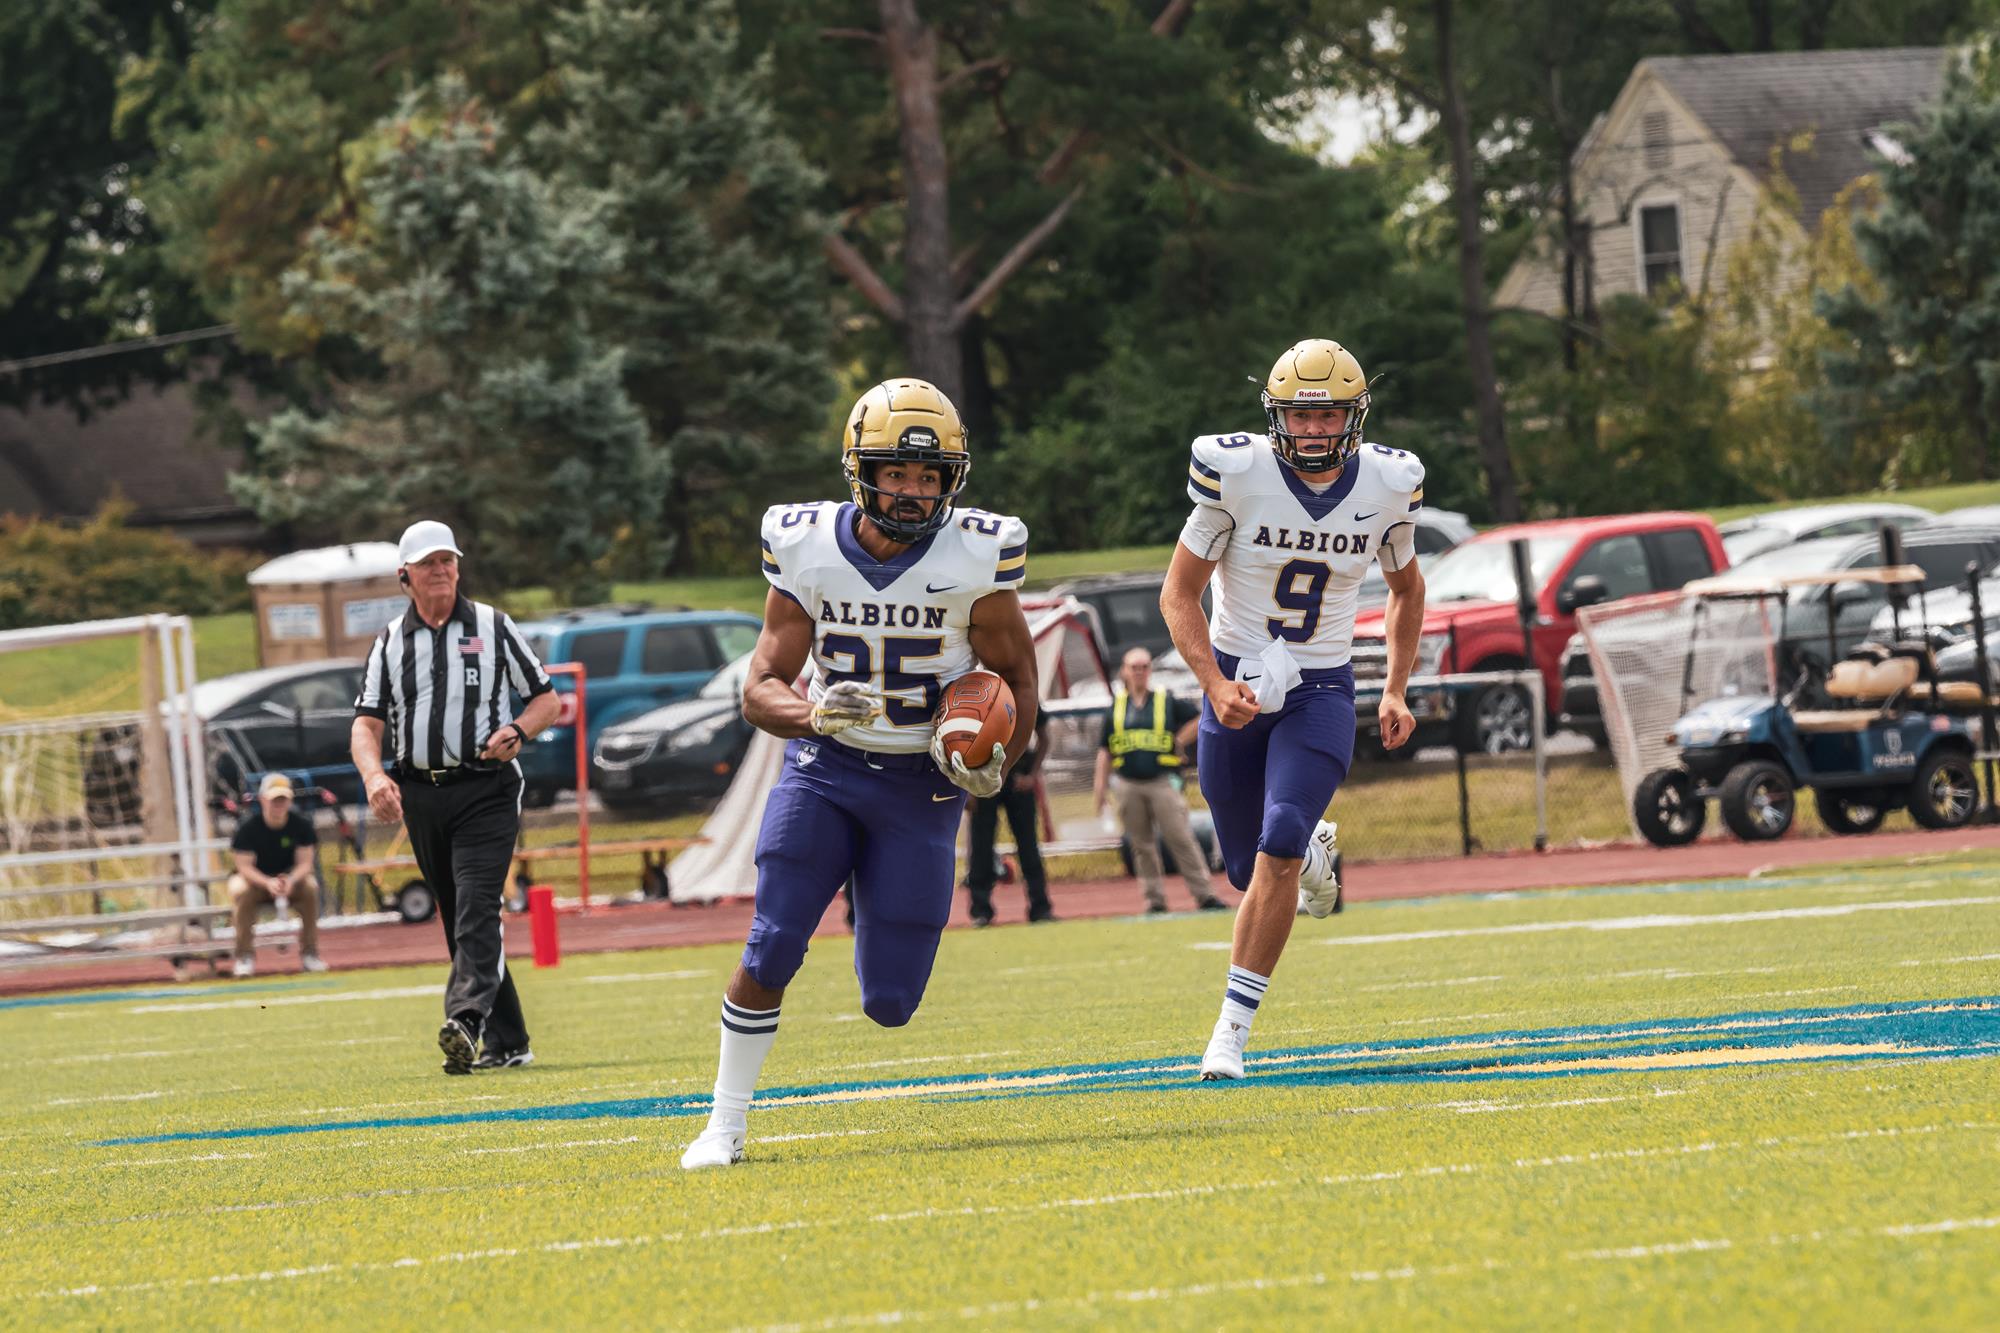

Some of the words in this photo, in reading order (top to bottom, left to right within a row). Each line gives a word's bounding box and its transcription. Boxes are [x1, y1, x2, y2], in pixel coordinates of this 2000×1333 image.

[1216, 434, 1253, 449] 9
[1252, 525, 1370, 555] ALBION
[820, 599, 948, 629] ALBION
[1265, 557, 1334, 645] 9
[465, 667, 480, 686] R
[818, 632, 945, 728] 25
